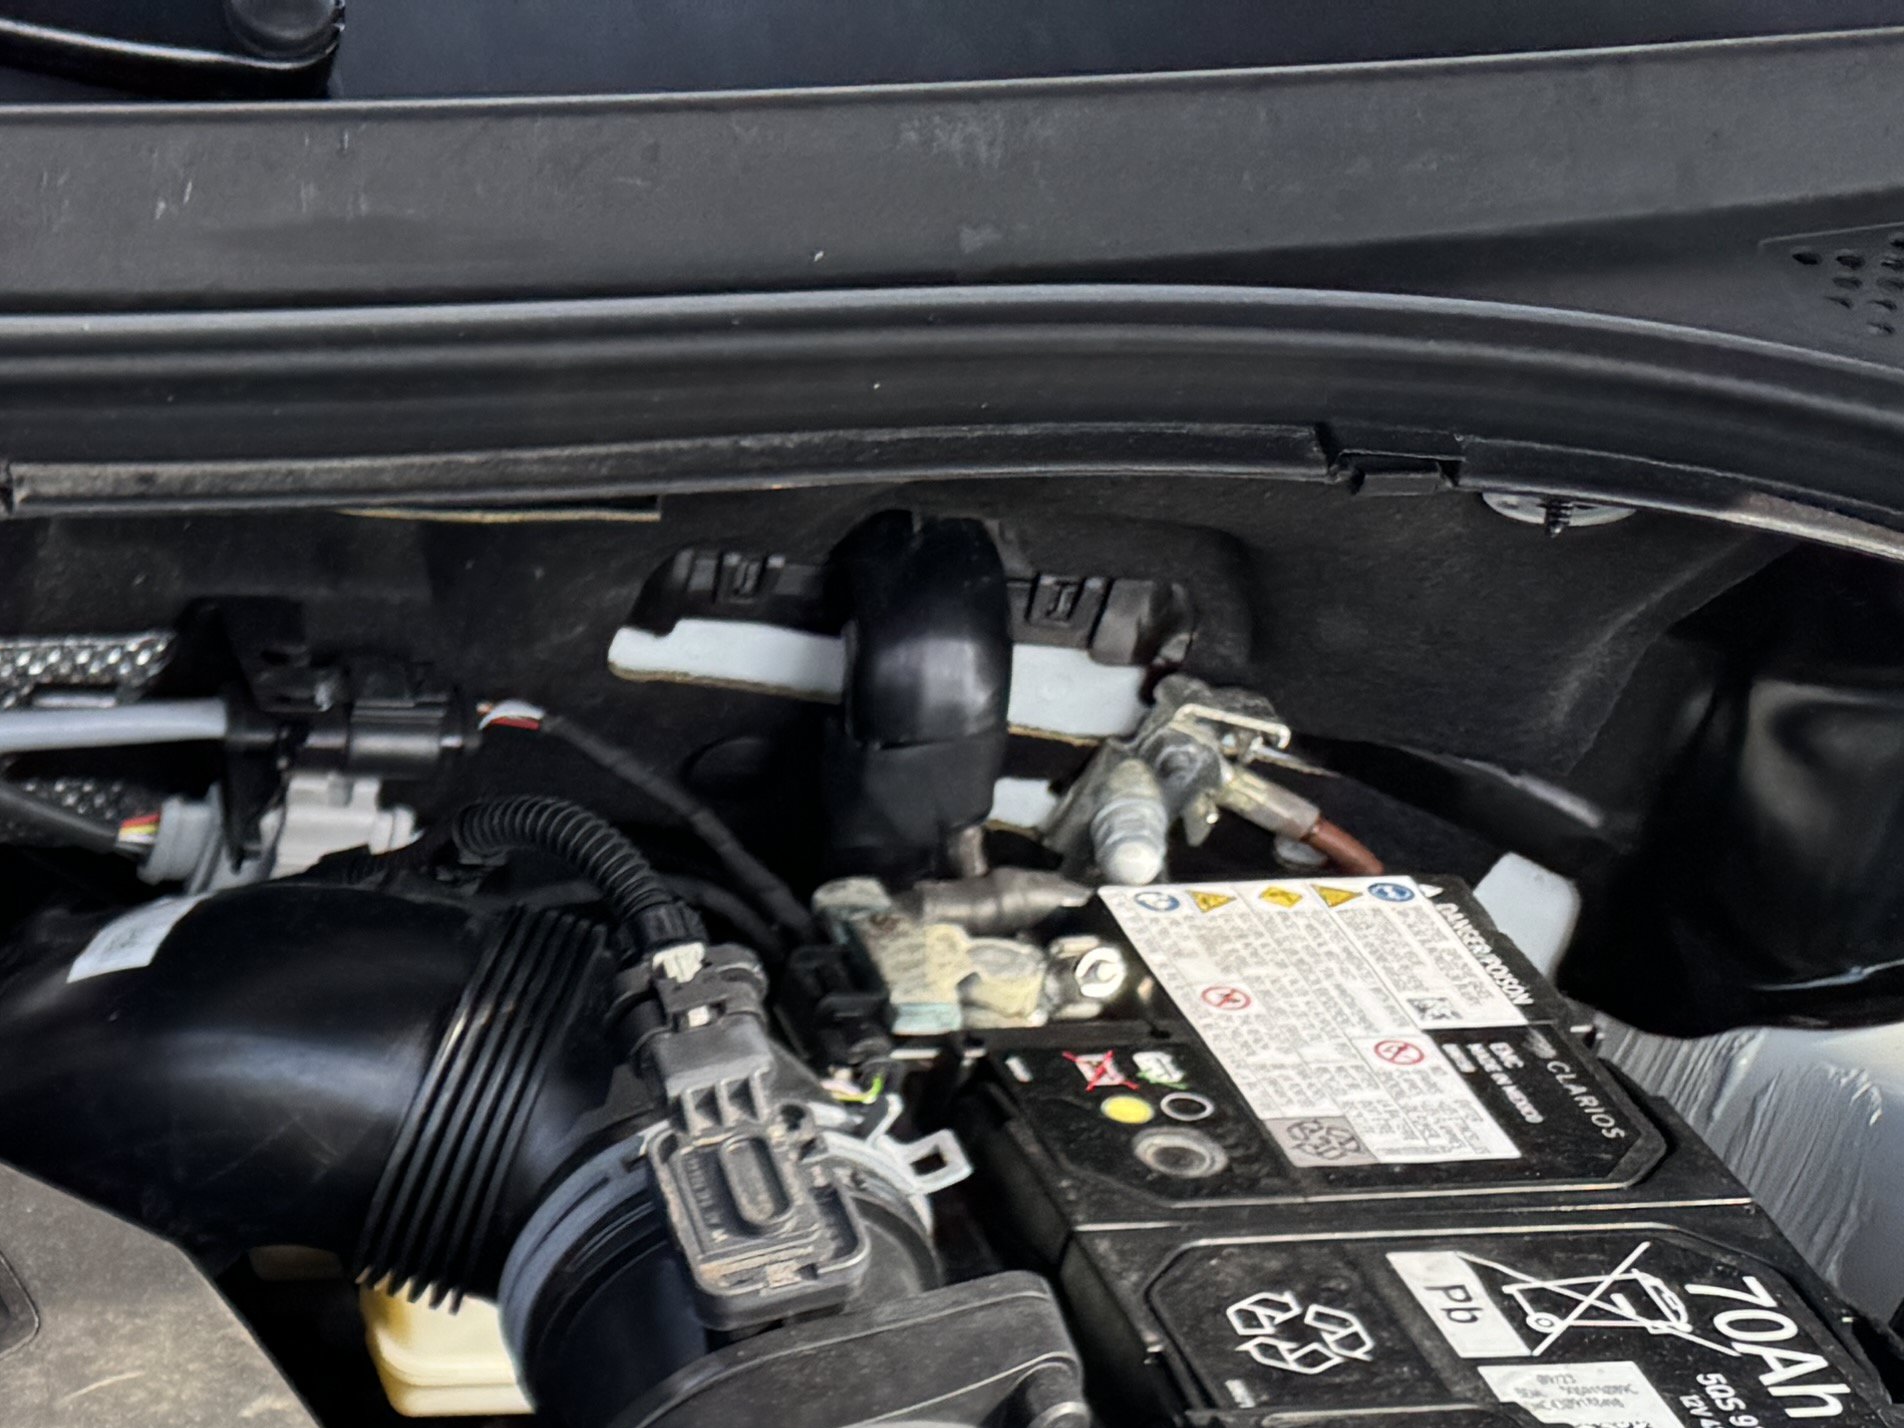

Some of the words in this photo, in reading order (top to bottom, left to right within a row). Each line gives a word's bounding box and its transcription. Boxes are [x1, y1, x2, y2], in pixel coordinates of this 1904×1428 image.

[1546, 1060, 1627, 1140] CLARIOS
[1423, 1284, 1484, 1324] Pb
[1684, 1275, 1851, 1418] 70Ah
[1679, 1394, 1711, 1418] 12V
